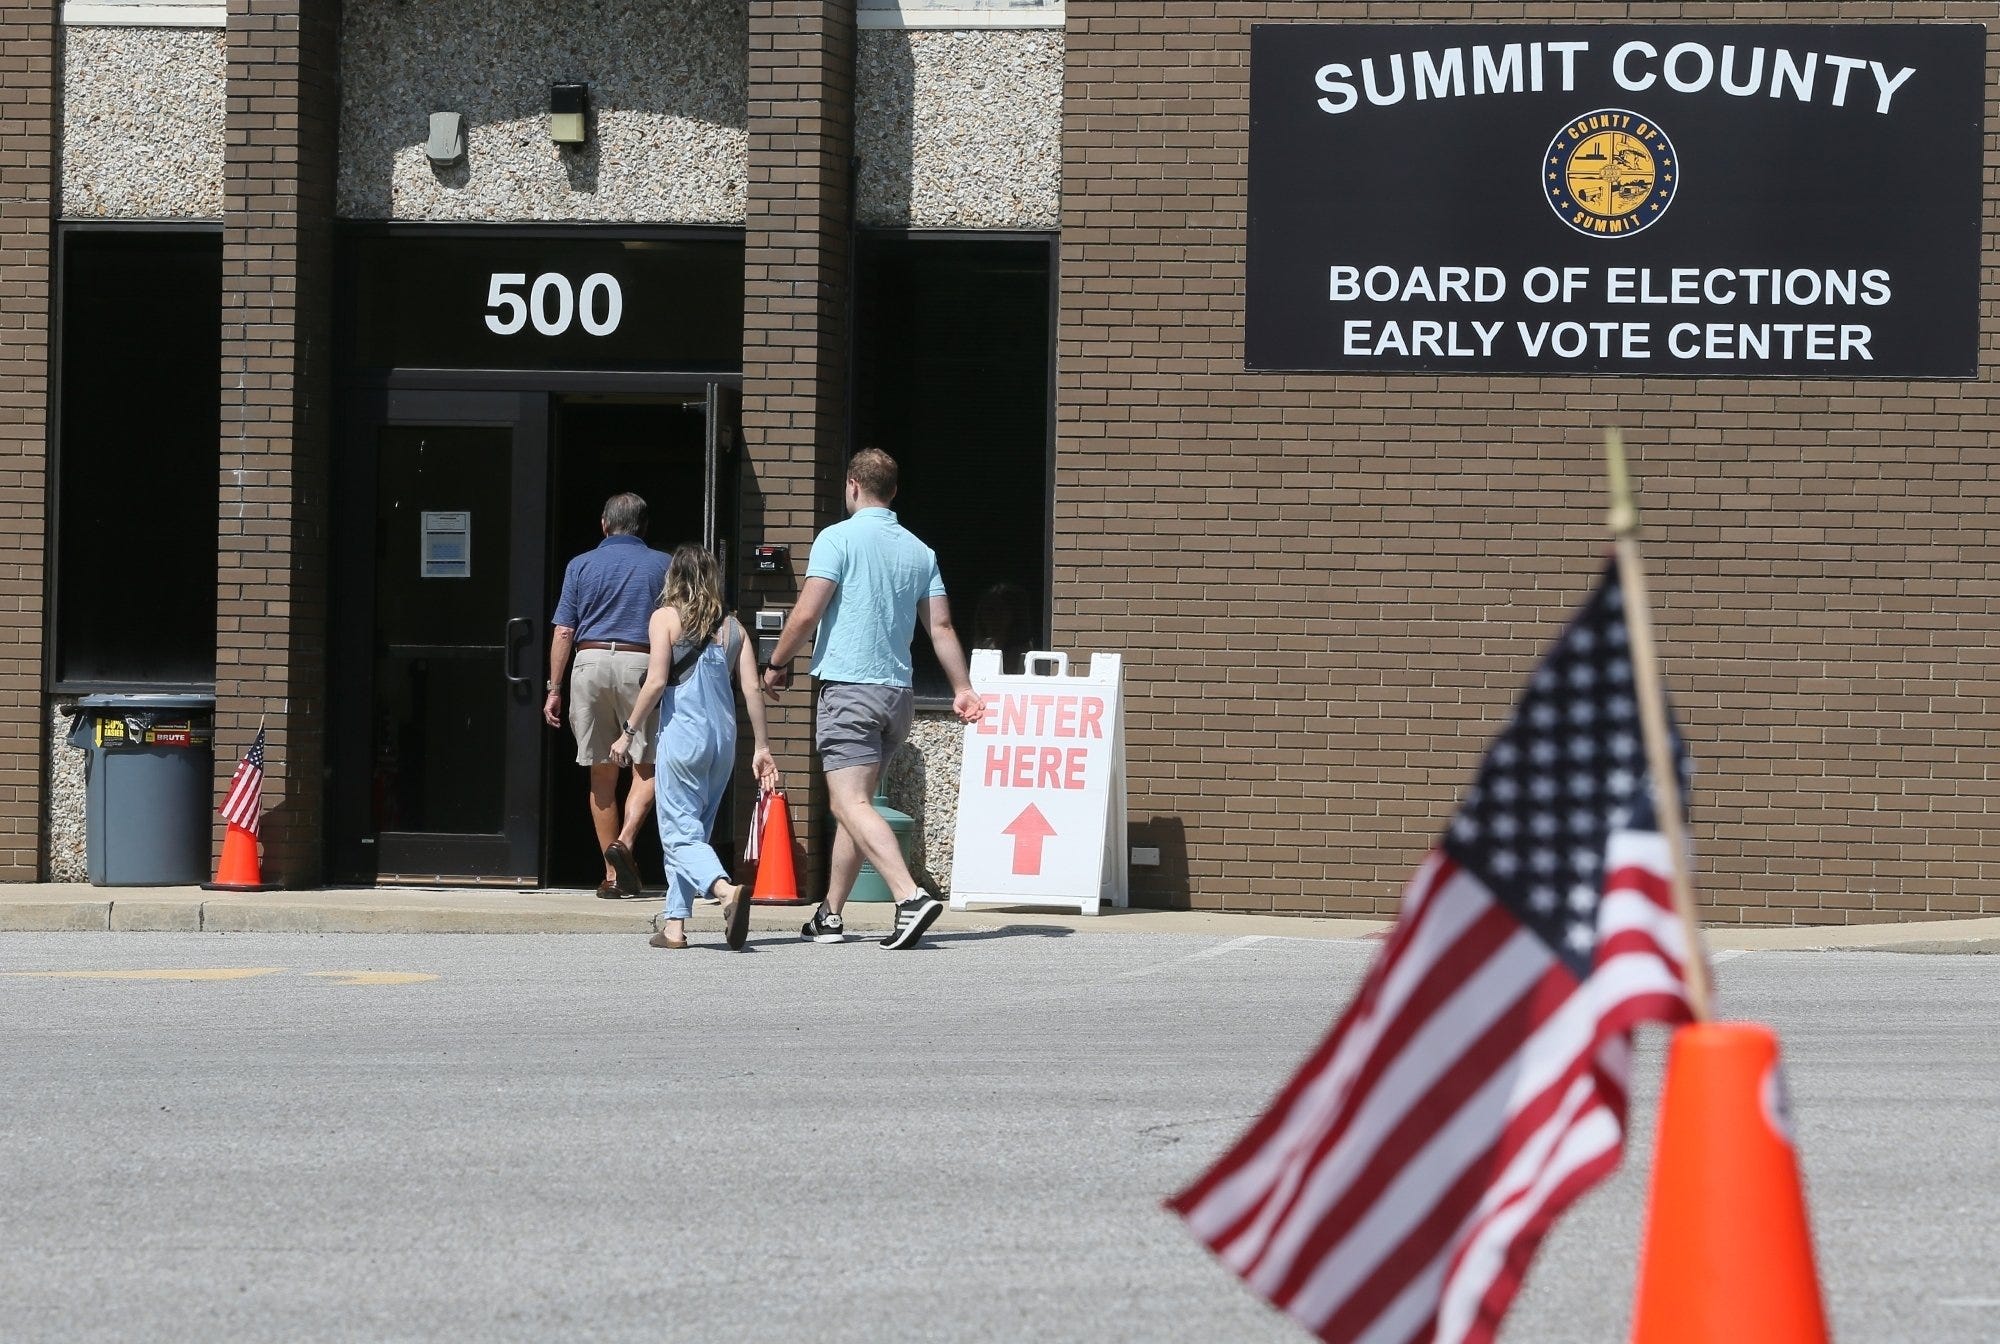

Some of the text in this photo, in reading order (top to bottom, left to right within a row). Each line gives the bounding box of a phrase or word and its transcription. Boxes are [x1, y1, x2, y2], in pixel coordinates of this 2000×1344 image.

[1314, 41, 1917, 114] SUMMIT COUNTY
[1567, 114, 1657, 141] COUNTY OF
[1573, 211, 1641, 233] SUMMIT
[484, 272, 623, 337] 500
[1329, 265, 1892, 306] BOARD OF ELECTIONS
[1343, 320, 1874, 361] EARLY VOTE CENTER
[104, 729, 124, 737] EASIER
[976, 693, 1105, 739] ENTER
[984, 745, 1088, 790] HERE
